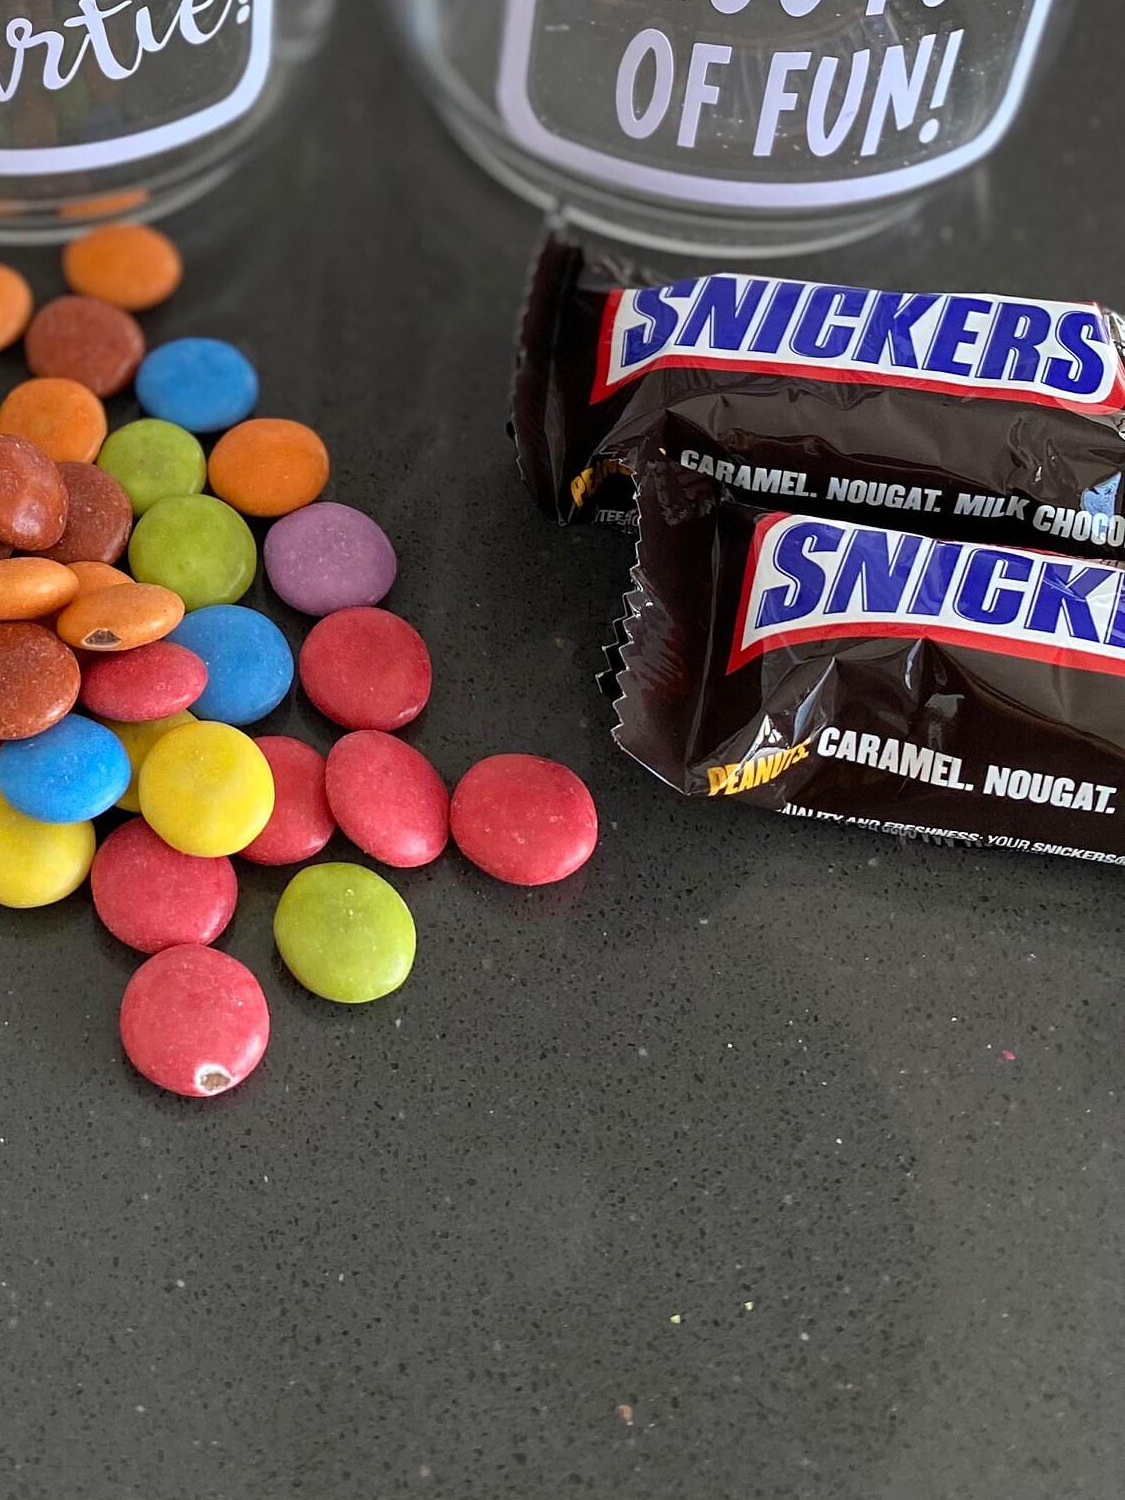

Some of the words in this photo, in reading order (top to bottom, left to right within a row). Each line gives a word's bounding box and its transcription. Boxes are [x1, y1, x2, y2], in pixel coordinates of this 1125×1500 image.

[615, 27, 732, 148] OF
[752, 29, 965, 157] FUN!
[620, 276, 1111, 396] SNICKERS
[680, 449, 818, 498] CARAMEL.
[826, 476, 943, 513] NOUGAT.
[953, 493, 1030, 520] MILK
[817, 726, 974, 792] CARAMEL.
[982, 764, 1117, 815] NOUGAT.
[987, 833, 1030, 851] YOUR
